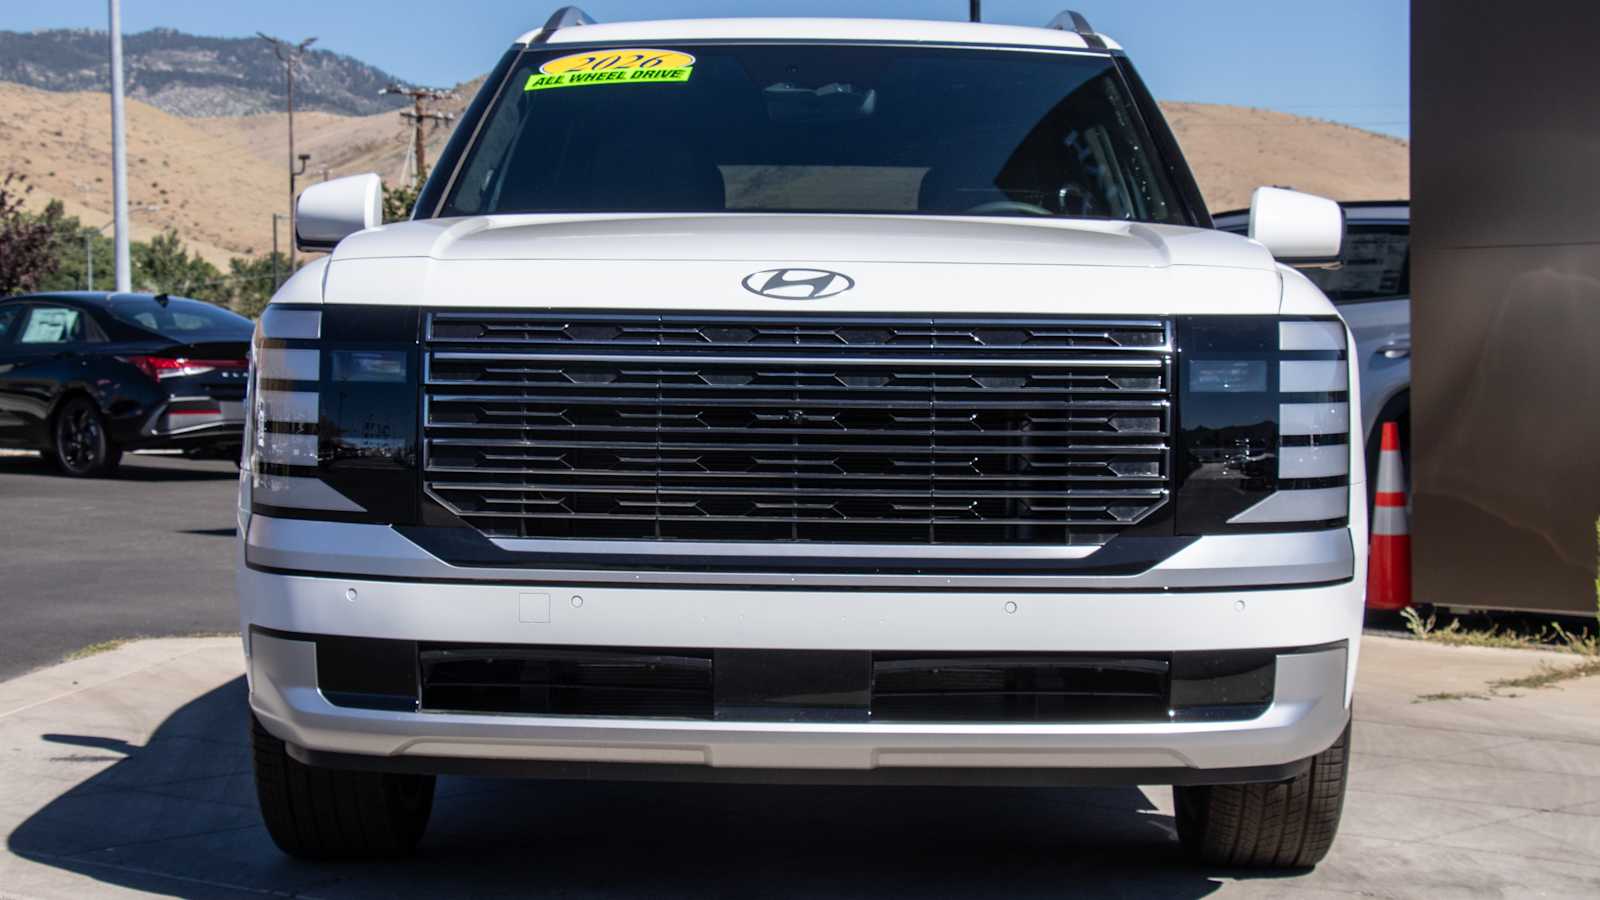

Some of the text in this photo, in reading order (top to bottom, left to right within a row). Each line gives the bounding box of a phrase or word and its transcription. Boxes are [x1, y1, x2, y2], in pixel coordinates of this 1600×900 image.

[567, 54, 672, 72] 2026
[532, 68, 684, 87] ALL WHEEL DRIVE
